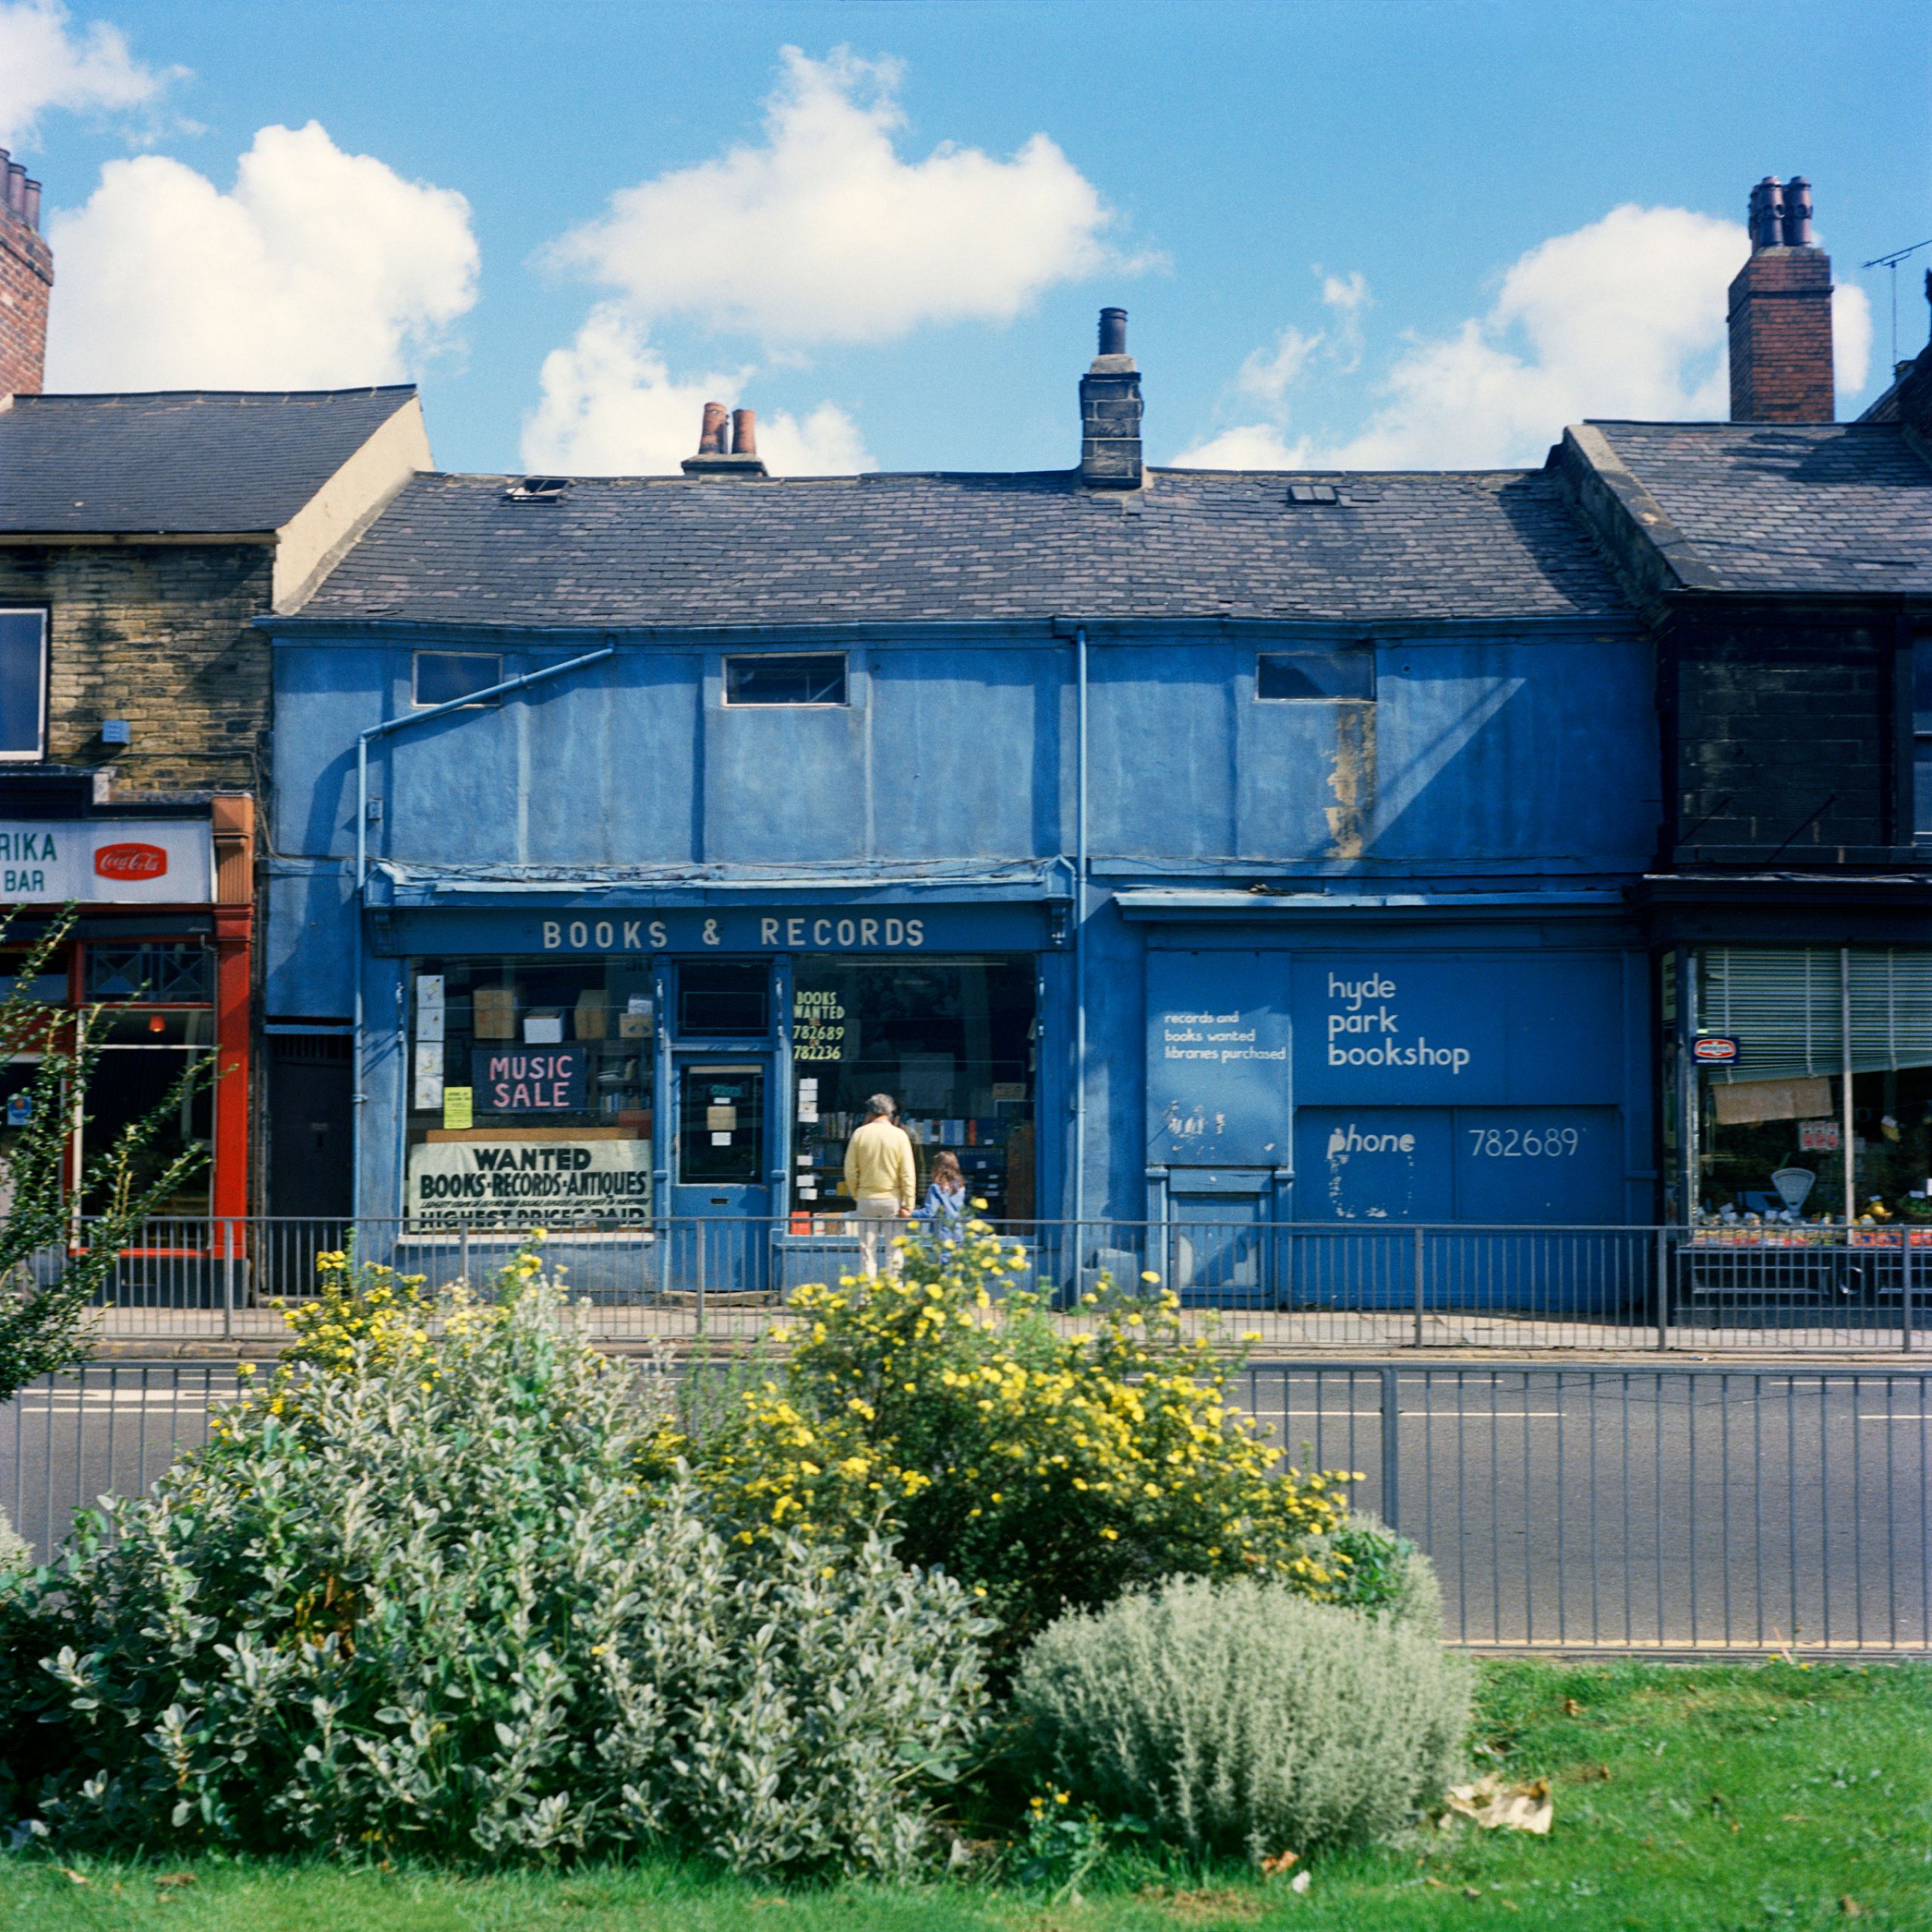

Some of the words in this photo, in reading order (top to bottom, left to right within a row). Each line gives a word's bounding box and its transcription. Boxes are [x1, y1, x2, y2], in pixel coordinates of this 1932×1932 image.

[0, 833, 57, 861] RIKA
[5, 869, 45, 892] BAR
[543, 921, 668, 949] BOOKS
[702, 918, 720, 946] &
[761, 917, 924, 946] RECORDS
[796, 991, 837, 1005] BOOKS
[1328, 971, 1396, 1011] hyde
[793, 1004, 844, 1020] WANTED
[1164, 1011, 1214, 1024] records
[1216, 1011, 1240, 1023] and
[1328, 1005, 1399, 1041] park
[792, 1025, 844, 1040] 782689
[1164, 1028, 1203, 1042] books
[1207, 1029, 1256, 1042] wanted
[792, 1045, 841, 1060] 782236
[1164, 1045, 1219, 1060] libraries
[1220, 1046, 1287, 1064] purchased
[1327, 1037, 1471, 1075] bookshop
[489, 1055, 574, 1081] MUSIC
[493, 1081, 571, 1108] SALE
[1326, 1124, 1416, 1160] phone
[1469, 1128, 1579, 1157] 782689
[473, 1147, 592, 1171] WANTED
[420, 1173, 486, 1199] BOOKS
[492, 1172, 561, 1197] RECORDS
[567, 1171, 647, 1198] ANTIQUES
[420, 1209, 512, 1228] HIGHEST
